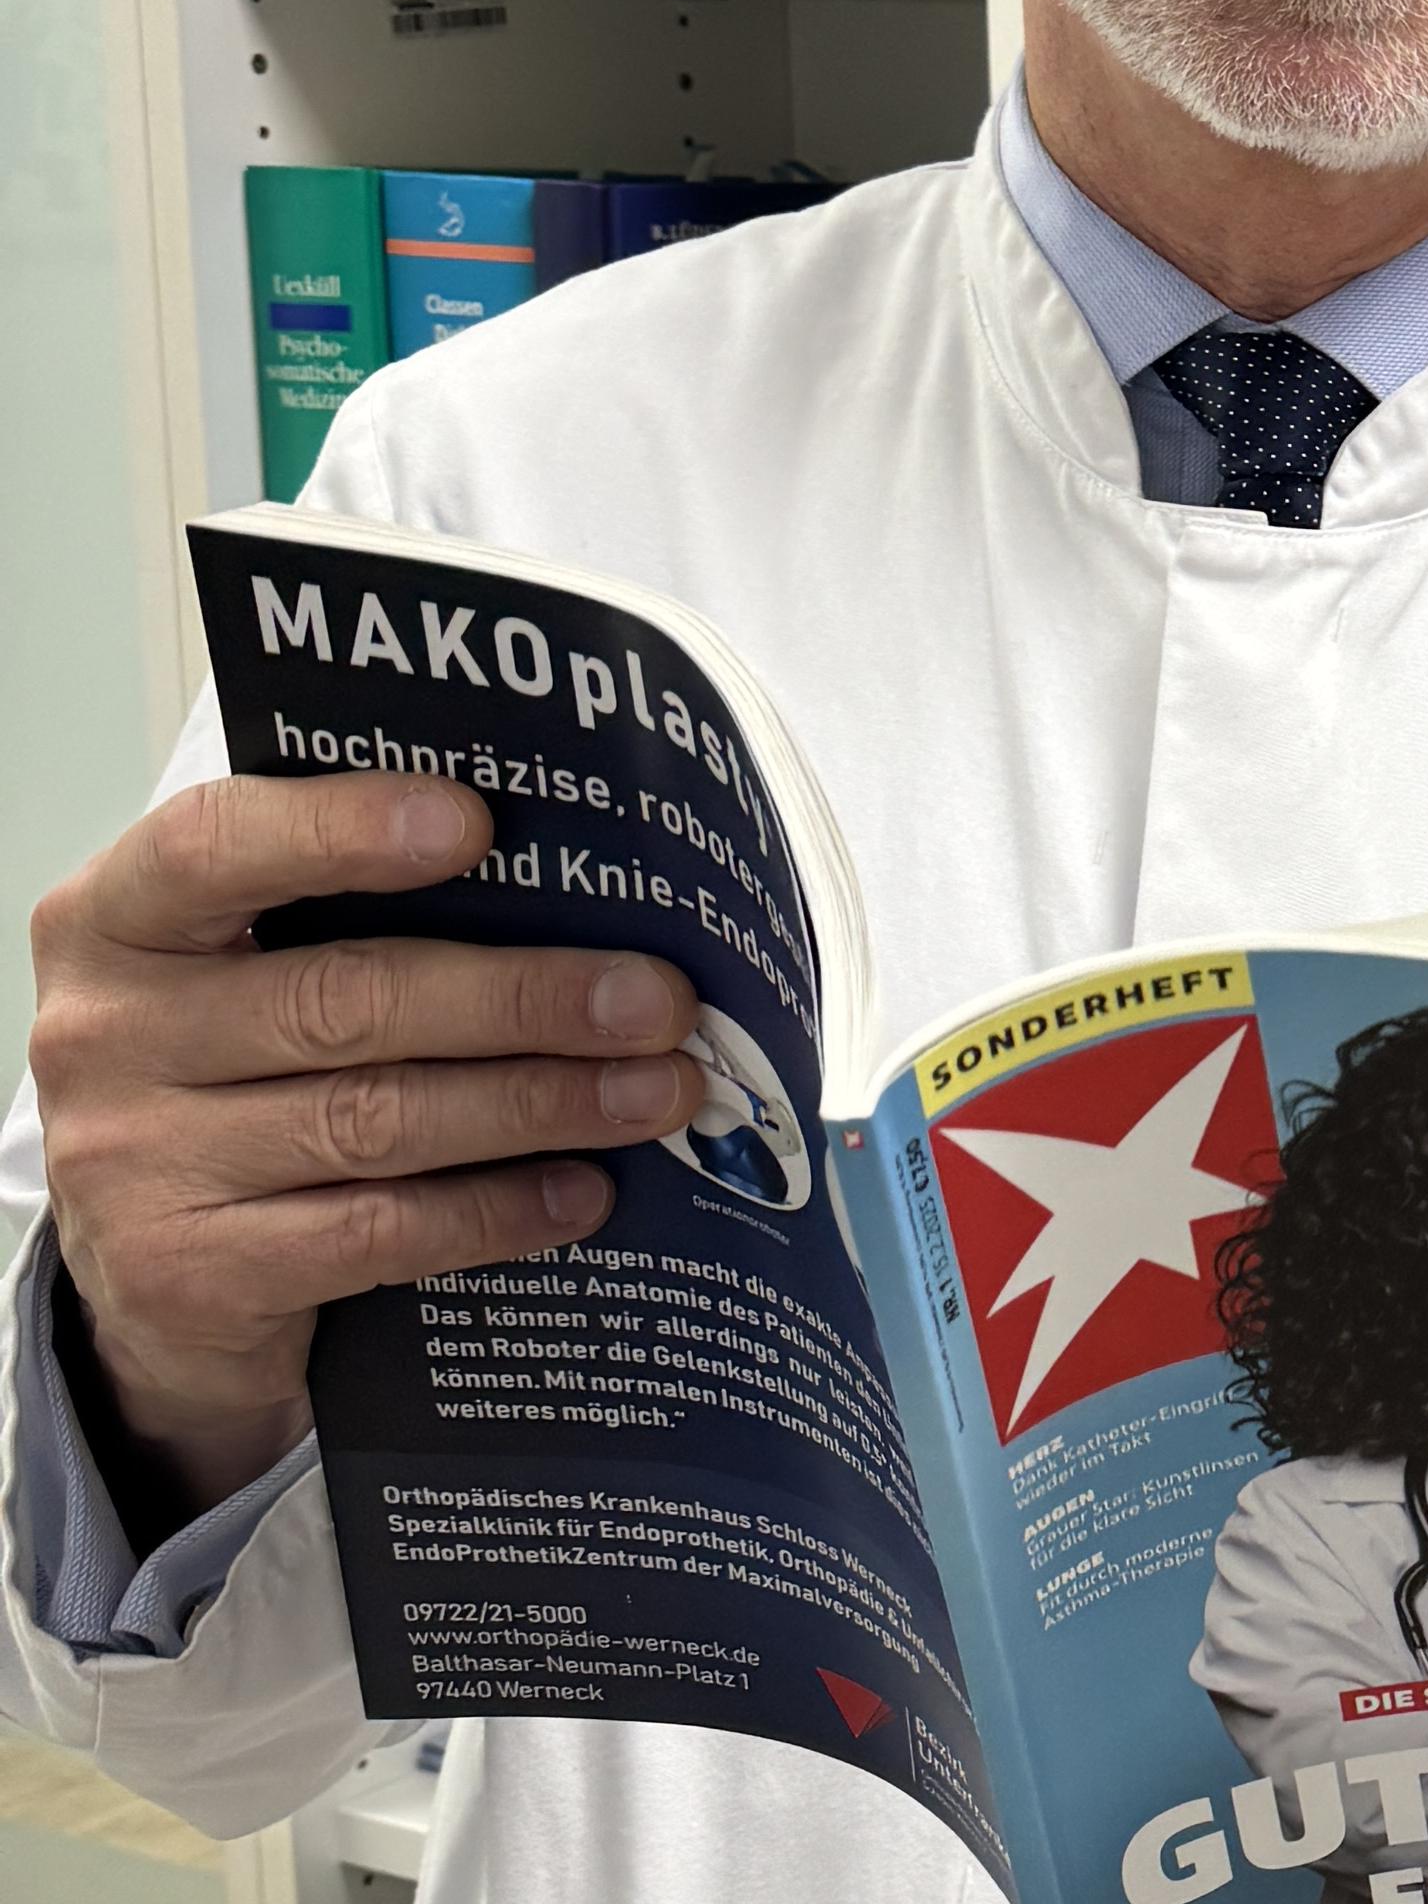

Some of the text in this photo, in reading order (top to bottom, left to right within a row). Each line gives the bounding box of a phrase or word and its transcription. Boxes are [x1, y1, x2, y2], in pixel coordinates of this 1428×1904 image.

[424, 294, 483, 316] Classen
[274, 711, 625, 817] hochpräzise,
[931, 966, 1234, 1092] SONDERHEFT
[567, 1243, 654, 1271] Augen
[660, 1255, 740, 1289] macht
[745, 1275, 778, 1304] die
[783, 1295, 842, 1349] exakte
[585, 1276, 712, 1311] Anatomie
[718, 1296, 760, 1326] des
[765, 1312, 853, 1386] Patienten
[420, 1303, 823, 1386] Das können wir allerdings nur
[426, 1337, 485, 1358] dem
[491, 1337, 601, 1360] Roboter
[607, 1341, 646, 1364] die
[653, 1345, 828, 1422] Gelenkstellung
[430, 1367, 863, 1476] können. Mit normalen Instrumenten
[435, 1399, 556, 1421] weiteres
[1008, 1434, 1065, 1480] HERZ
[1011, 1459, 1058, 1495] Dank
[1014, 1431, 1152, 1511] wieder im Takt
[1023, 1488, 1096, 1543] AUGEN
[1025, 1511, 1087, 1556] Grauer
[1141, 1450, 1259, 1494] Kunstlinsen
[1029, 1483, 1194, 1571] für die klare Sicht
[382, 1484, 913, 1619] Orthopädisches Krankenhaus Schloss Werneck
[388, 1514, 551, 1537] Spezialklinik
[557, 1518, 594, 1538] für
[779, 1549, 884, 1616] Orthopädie
[1035, 1550, 1105, 1602] LUNGE
[1039, 1526, 1214, 1617] Fit durch moderne
[1043, 1545, 1205, 1632] Asthma-Therapie
[393, 1543, 921, 1675] EndoProthetikZentrum der Maximalversorgung
[403, 1601, 587, 1626] 09722/21-5000
[407, 1628, 761, 1666] www.orthopädie-werneck.de
[412, 1655, 749, 1690] Balthasar-Neumann-Platz 1
[416, 1680, 605, 1701] 97440 Werneck
[1355, 1689, 1415, 1715] DIE
